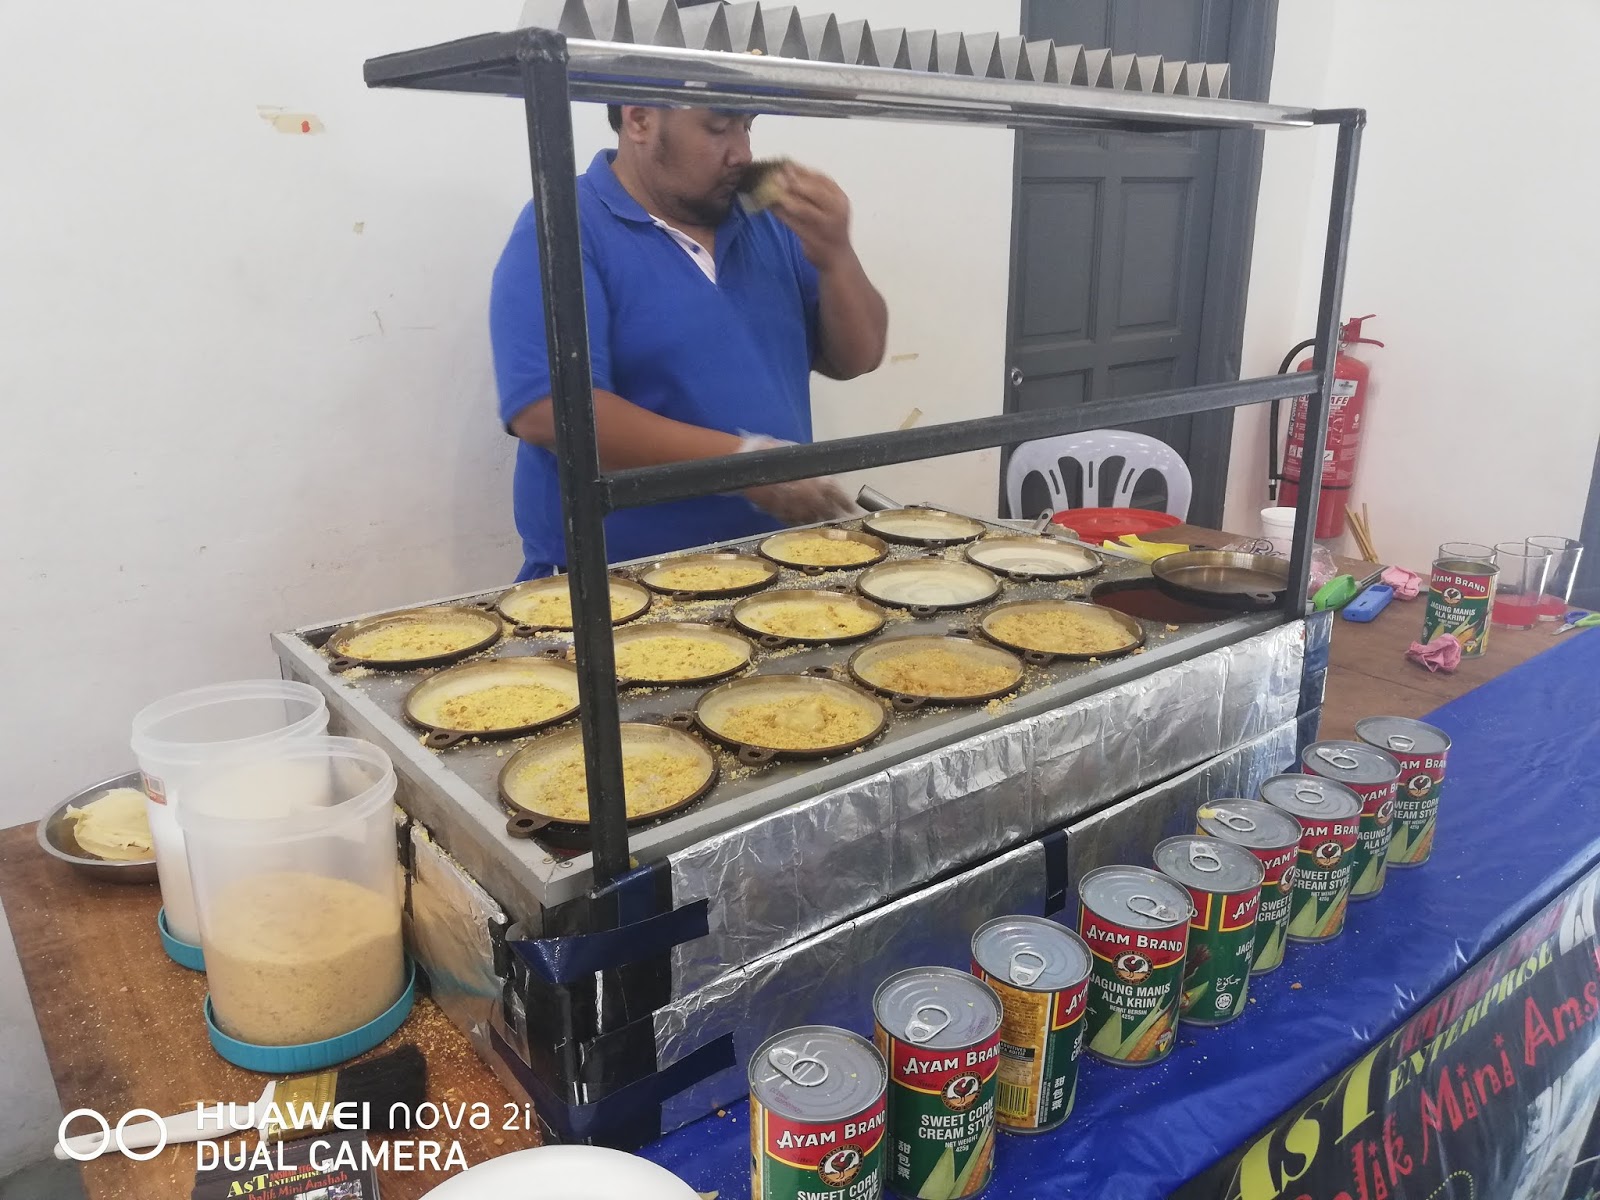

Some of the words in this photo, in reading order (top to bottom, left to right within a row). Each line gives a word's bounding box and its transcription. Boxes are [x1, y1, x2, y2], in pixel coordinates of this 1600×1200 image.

[1432, 574, 1452, 583] AYAM
[1455, 577, 1486, 593] BRAND
[1435, 611, 1446, 619] ALA
[1447, 614, 1466, 622] KRIM
[1453, 608, 1476, 616] MANIS
[1400, 761, 1420, 770] AM
[1361, 788, 1387, 802] YAM
[1395, 801, 1420, 810] WEET
[1394, 810, 1417, 819] REAM
[1334, 824, 1359, 836] BRAN
[1357, 828, 1386, 840] AGUNG
[1364, 840, 1380, 850] ALA
[1263, 852, 1291, 870] YAM
[1295, 868, 1329, 880] SWEET
[1261, 895, 1289, 911] SWEET
[1258, 906, 1286, 922] CREAM
[1086, 924, 1130, 946] AYAM
[1137, 935, 1183, 952] BRAND
[1089, 973, 1133, 996] JAGUNG
[1136, 981, 1171, 997] MANIS
[1102, 991, 1123, 1006] ALA
[1126, 997, 1157, 1008] KRIM
[903, 1058, 959, 1075] AYAM
[966, 1042, 1000, 1067] BRAN
[1420, 1033, 1515, 1165] Mini
[921, 1113, 966, 1128] SWEET
[968, 1096, 994, 1122] CORN
[918, 1127, 964, 1140] CREAM
[967, 1107, 994, 1136] STYLE
[777, 1131, 836, 1149] AYAM
[957, 1134, 978, 1147] WEIGHT
[955, 1144, 970, 1153] 425g
[269, 1171, 321, 1187] ENTERPRISE
[849, 1168, 878, 1197] CORN
[279, 1183, 303, 1196] Mini
